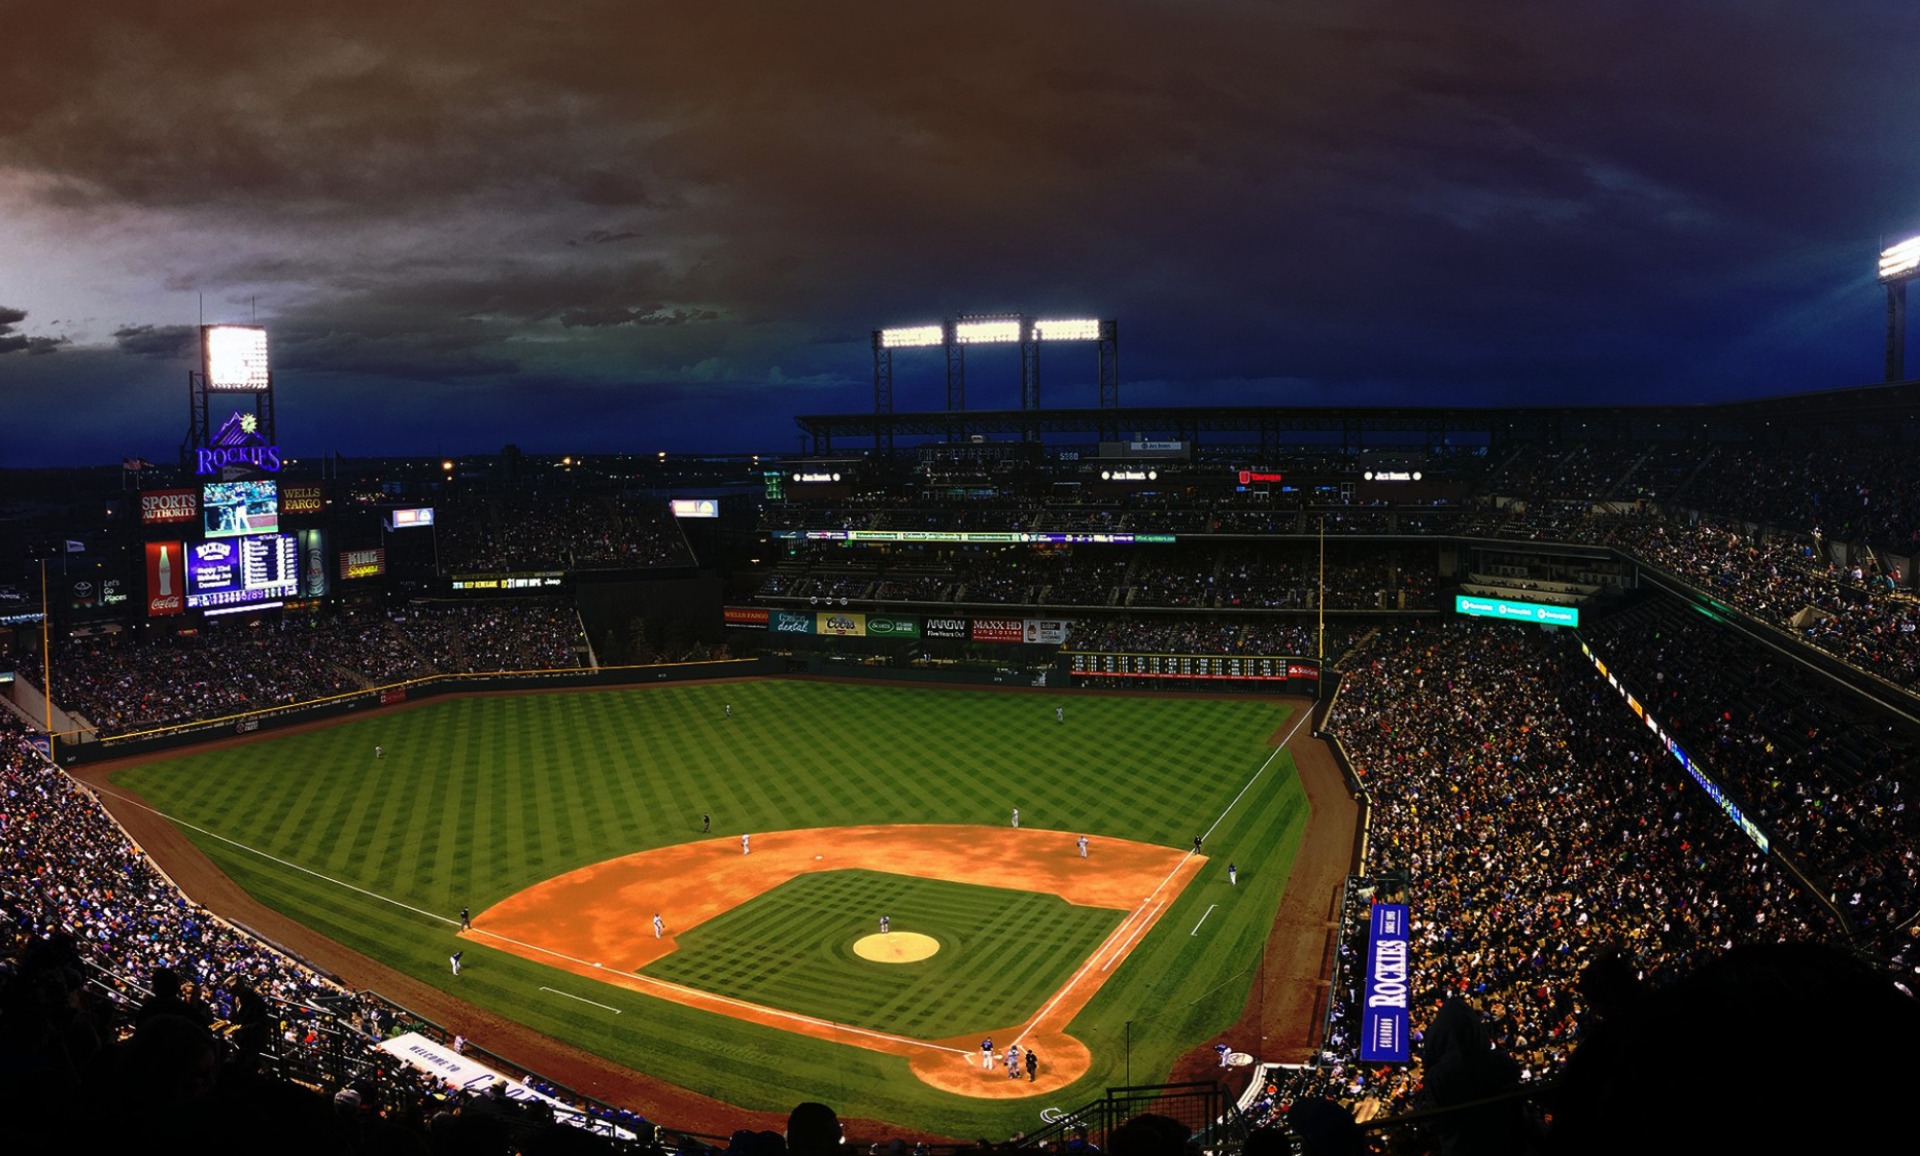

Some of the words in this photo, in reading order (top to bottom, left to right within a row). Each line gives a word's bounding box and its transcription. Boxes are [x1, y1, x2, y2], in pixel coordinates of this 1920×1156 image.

[195, 446, 280, 474] ROCKIES
[284, 488, 320, 499] WELLS
[142, 493, 196, 510] SPORTS
[285, 498, 320, 510] FARGO
[143, 508, 197, 519] AUTHORITY
[348, 551, 378, 565] KING
[103, 578, 120, 587] Let's
[103, 587, 115, 595] Go
[104, 594, 128, 602] Places
[747, 611, 769, 619] FARGO
[826, 617, 855, 629] Coors
[927, 618, 965, 630] ARROW
[973, 620, 1005, 629] MAXX
[1006, 621, 1022, 630] HD
[1368, 940, 1407, 1008] ROCKIES
[1379, 1018, 1393, 1048] COLORADO
[409, 1045, 449, 1066] WELCOME
[446, 1064, 462, 1073] TO
